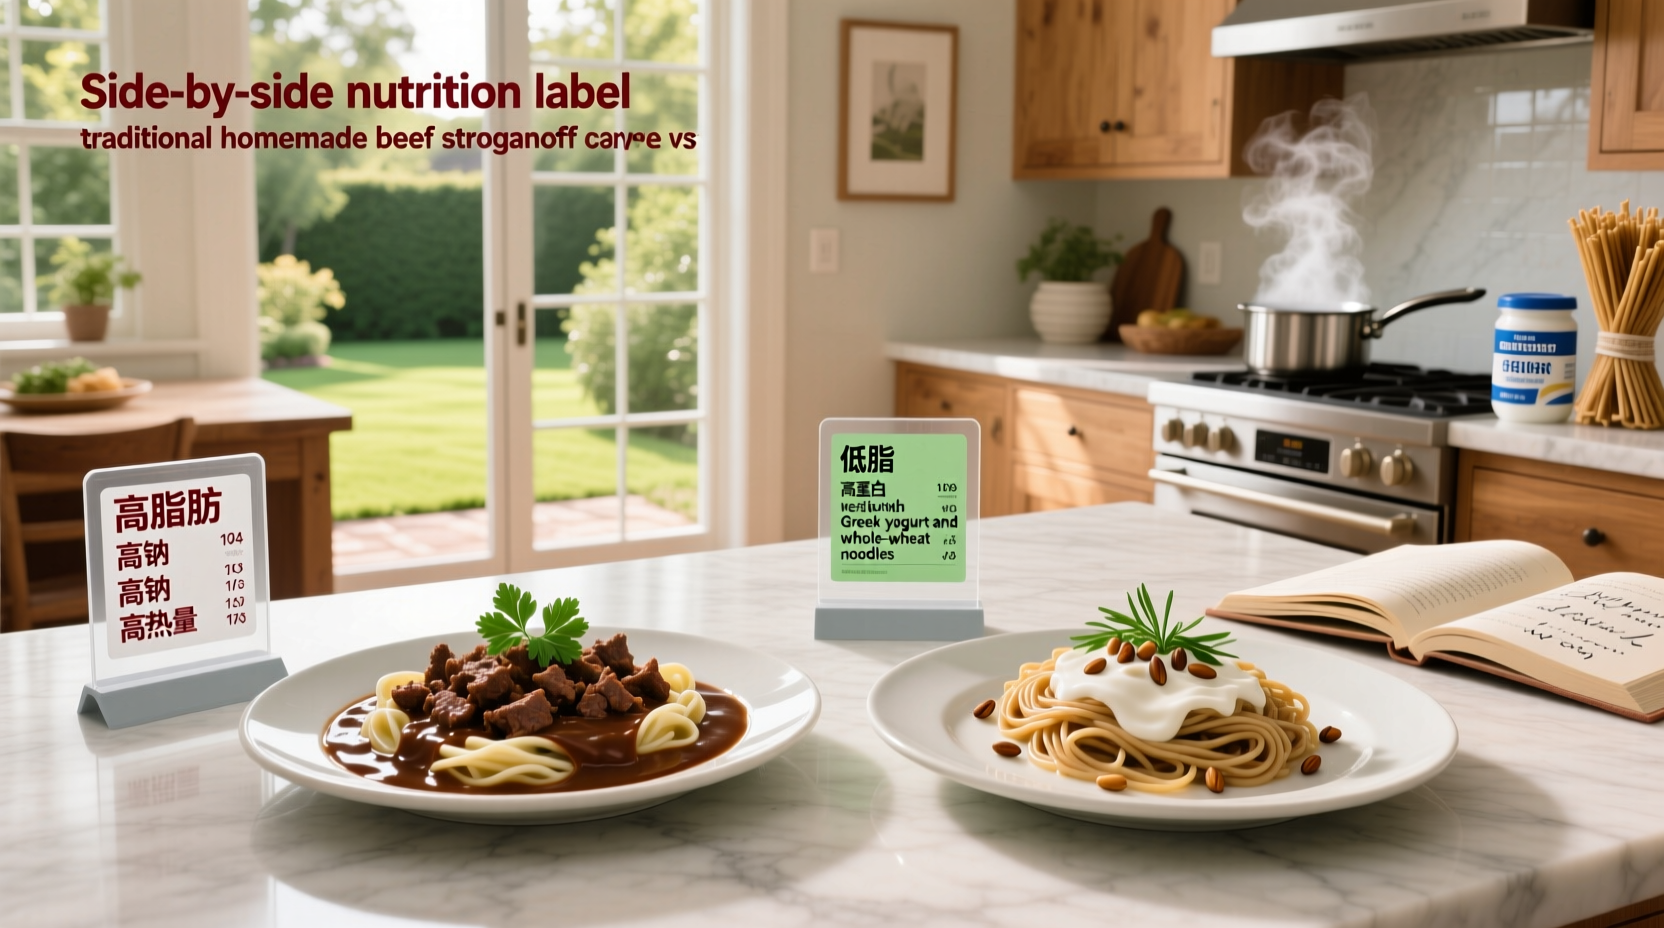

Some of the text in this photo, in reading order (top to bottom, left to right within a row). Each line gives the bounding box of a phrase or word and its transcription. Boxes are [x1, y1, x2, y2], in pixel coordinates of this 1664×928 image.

[840, 444, 895, 474] 低脂
[113, 486, 222, 533] 高脂肪
[840, 515, 958, 532] Greek yogurt and
[220, 531, 243, 546] 104
[840, 530, 931, 545] whole-wheat
[116, 538, 169, 571] 高钠
[840, 546, 895, 560] noodles
[117, 574, 171, 608] 高钠
[119, 606, 198, 643] 高热量
